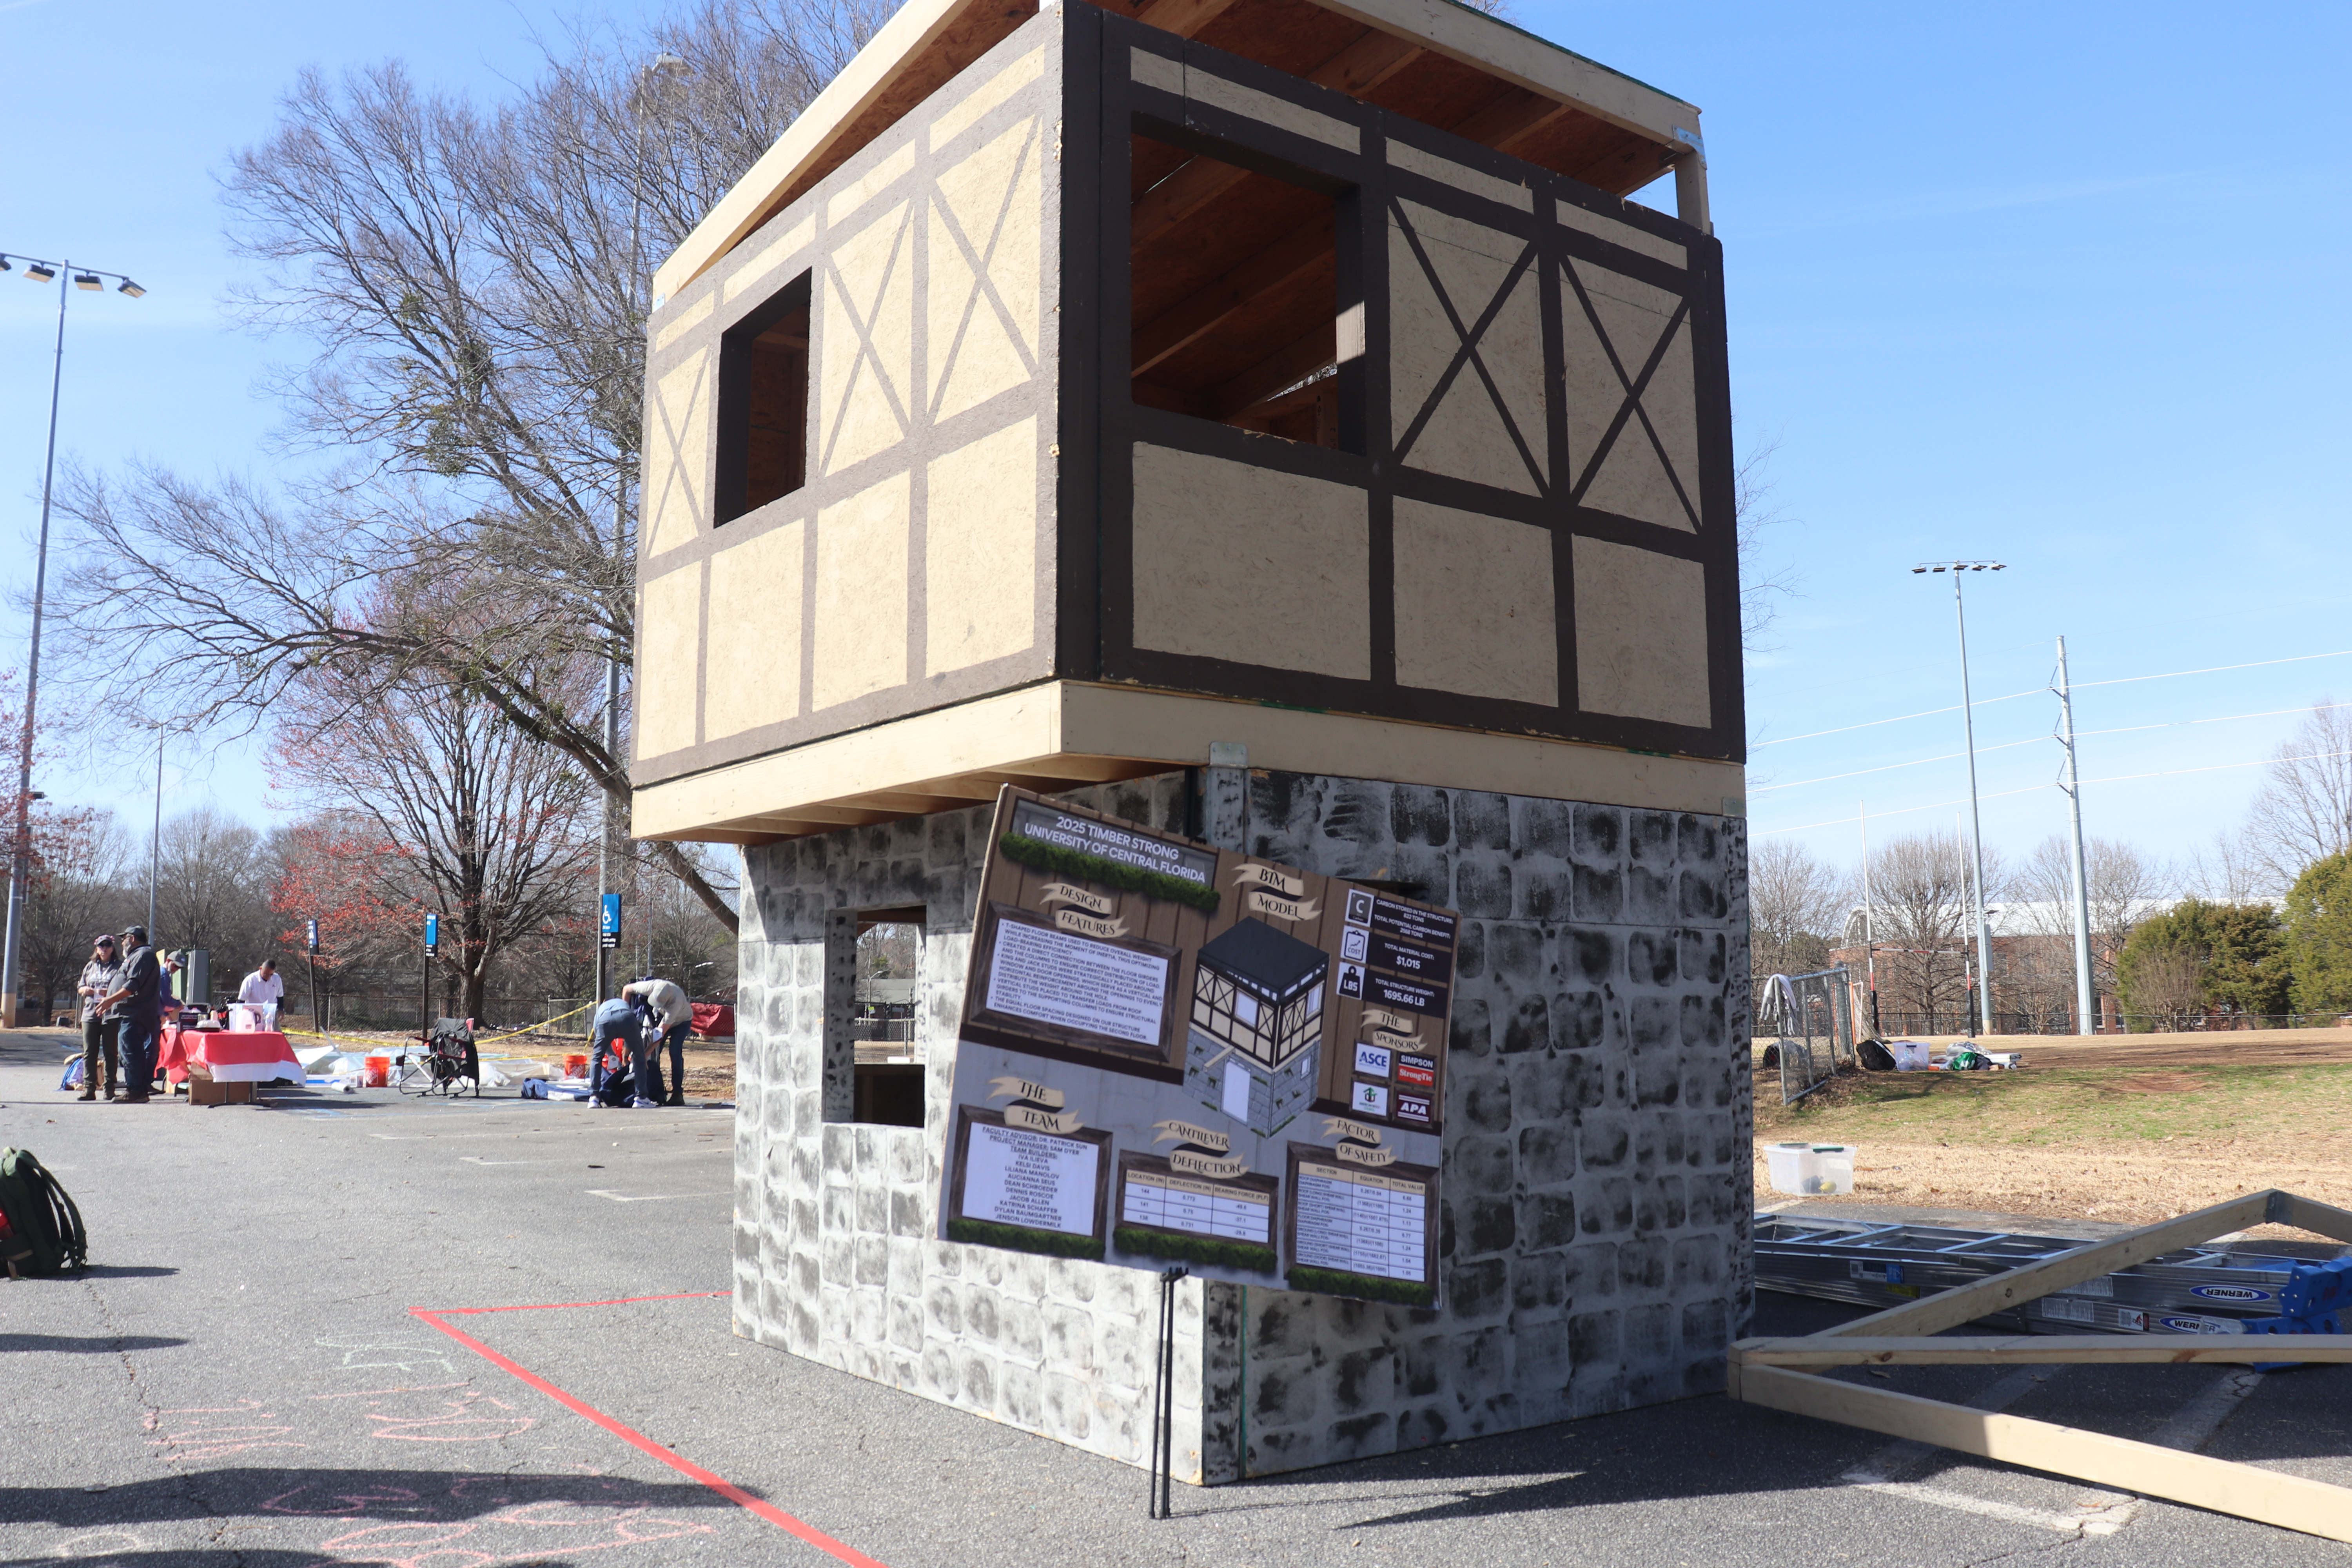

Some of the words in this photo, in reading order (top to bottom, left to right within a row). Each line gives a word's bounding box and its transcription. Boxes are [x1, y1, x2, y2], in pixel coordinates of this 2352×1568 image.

[1055, 815, 1086, 835] 2025
[1087, 824, 1131, 847] TIMBER
[1131, 837, 1180, 861] STRONG
[1023, 822, 1091, 853] UNIVERSITY
[1091, 841, 1108, 857] OF
[1108, 846, 1159, 871] CENTRAL
[1159, 860, 1206, 884] FLORIDA
[1259, 869, 1288, 892] BTM
[1060, 886, 1102, 912] DESIGN
[1356, 899, 1364, 914] C
[1376, 899, 1395, 909] CARBON
[1395, 904, 1413, 913] STORED
[1257, 896, 1304, 920] MODEL
[1062, 913, 1115, 935] FEATURES
[1374, 914, 1388, 922] TOTAL
[1388, 918, 1412, 929] POTENTIAL
[1412, 924, 1431, 934] CARBON
[1003, 935, 1042, 949] LOAD-BEARING
[1005, 923, 1031, 933] T-SHAPED
[1031, 929, 1049, 938] FLOOR
[1049, 933, 1067, 942] BEAMS
[1089, 943, 1109, 953] REDUCE
[1109, 948, 1131, 958] OVERALL
[1132, 953, 1152, 963] WEIGHT
[1384, 943, 1398, 951] TOTAL
[1398, 946, 1420, 956] MATERIAL
[1004, 929, 1022, 937] WHILE
[1022, 933, 1053, 945] INCREASING
[1064, 943, 1088, 953] MOMENT
[1130, 959, 1160, 971] OPTIMIZING
[1348, 947, 1361, 955] COST
[1002, 941, 1026, 951] CREATED
[1031, 947, 1050, 957] DIRECT
[1050, 952, 1085, 965] CONNECTION
[1085, 960, 1110, 971] BETWEEN
[1120, 969, 1138, 977] FLOOR
[1138, 973, 1158, 982] GIRDERS
[1396, 955, 1421, 971] $1,015
[1343, 979, 1358, 992] LBS
[1375, 978, 1389, 986] TOTAL
[1389, 982, 1415, 993] STRUCTURE
[1383, 988, 1414, 1005] 1695.66
[1414, 996, 1425, 1007] LB
[1380, 1013, 1401, 1028] THE
[1375, 1033, 1419, 1051] SPONSORS
[1359, 1051, 1387, 1067] ASCE
[1401, 1055, 1433, 1068] SIMPSON
[1018, 1080, 1047, 1101] THE
[1400, 1102, 1426, 1115] APA
[1022, 1110, 1060, 1131] TEAM
[982, 1127, 1009, 1136] FACULTY
[1049, 1138, 1075, 1148] PATRICK
[1169, 1121, 1231, 1149] CANTILEVER
[1336, 1119, 1376, 1142] FACTOR
[989, 1135, 1016, 1145] PROJECT
[1339, 1145, 1354, 1156] OF
[1354, 1148, 1388, 1163] SAFETY
[1172, 1154, 1242, 1175] DEFLECTION
[1028, 1170, 1059, 1179] MANOLOV
[1127, 1172, 1155, 1181] LOCATION
[1360, 1176, 1383, 1184] EQUATION
[1021, 1183, 1058, 1193] SCHROEDER
[1169, 1180, 1202, 1190] DEFLECTION
[1214, 1187, 1238, 1196] BEARING
[1005, 1187, 1028, 1195] DENNIS
[1028, 1191, 1054, 1199] ROSCOE
[999, 1200, 1026, 1209] KATRINA
[1026, 1205, 1058, 1214] SCHAFFER
[995, 1214, 1020, 1222] JENSON
[1020, 1218, 1061, 1228] LOWDERMILK
[1015, 1210, 1062, 1221] BAUMGARTNER
[2205, 1288, 2254, 1298] WERNER
